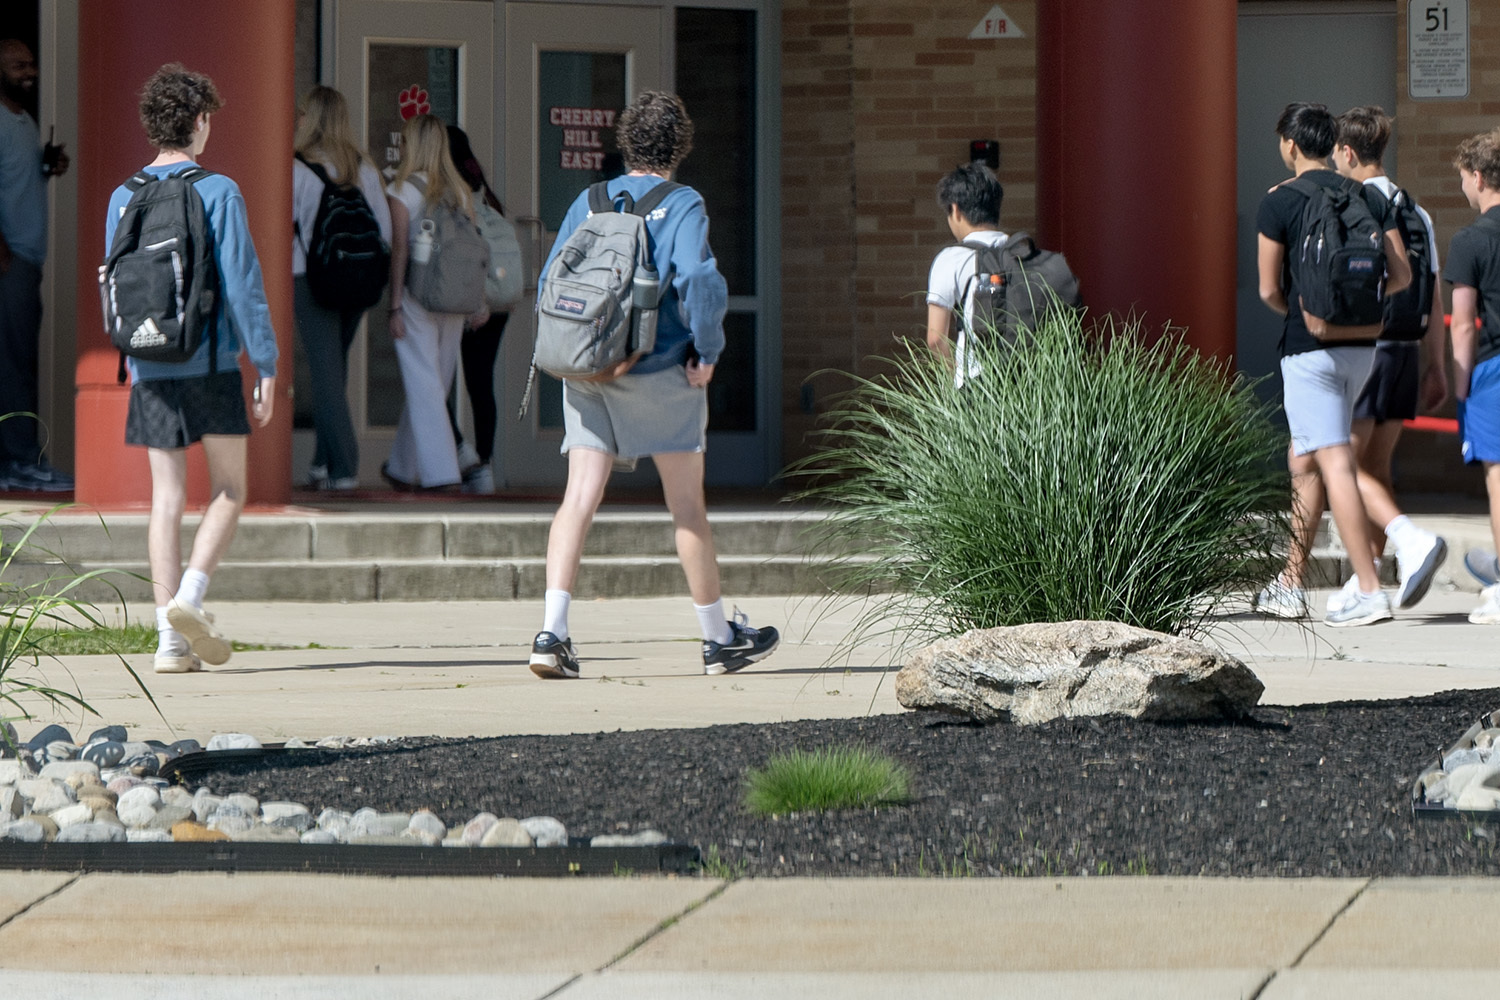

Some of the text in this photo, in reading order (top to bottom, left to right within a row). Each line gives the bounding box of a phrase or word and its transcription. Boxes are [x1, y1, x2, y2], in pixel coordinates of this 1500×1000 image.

[985, 19, 1007, 35] F/R
[1425, 7, 1448, 32] 51
[550, 107, 616, 128] CHERRY
[563, 129, 603, 148] HILL
[560, 150, 606, 170] EAST
